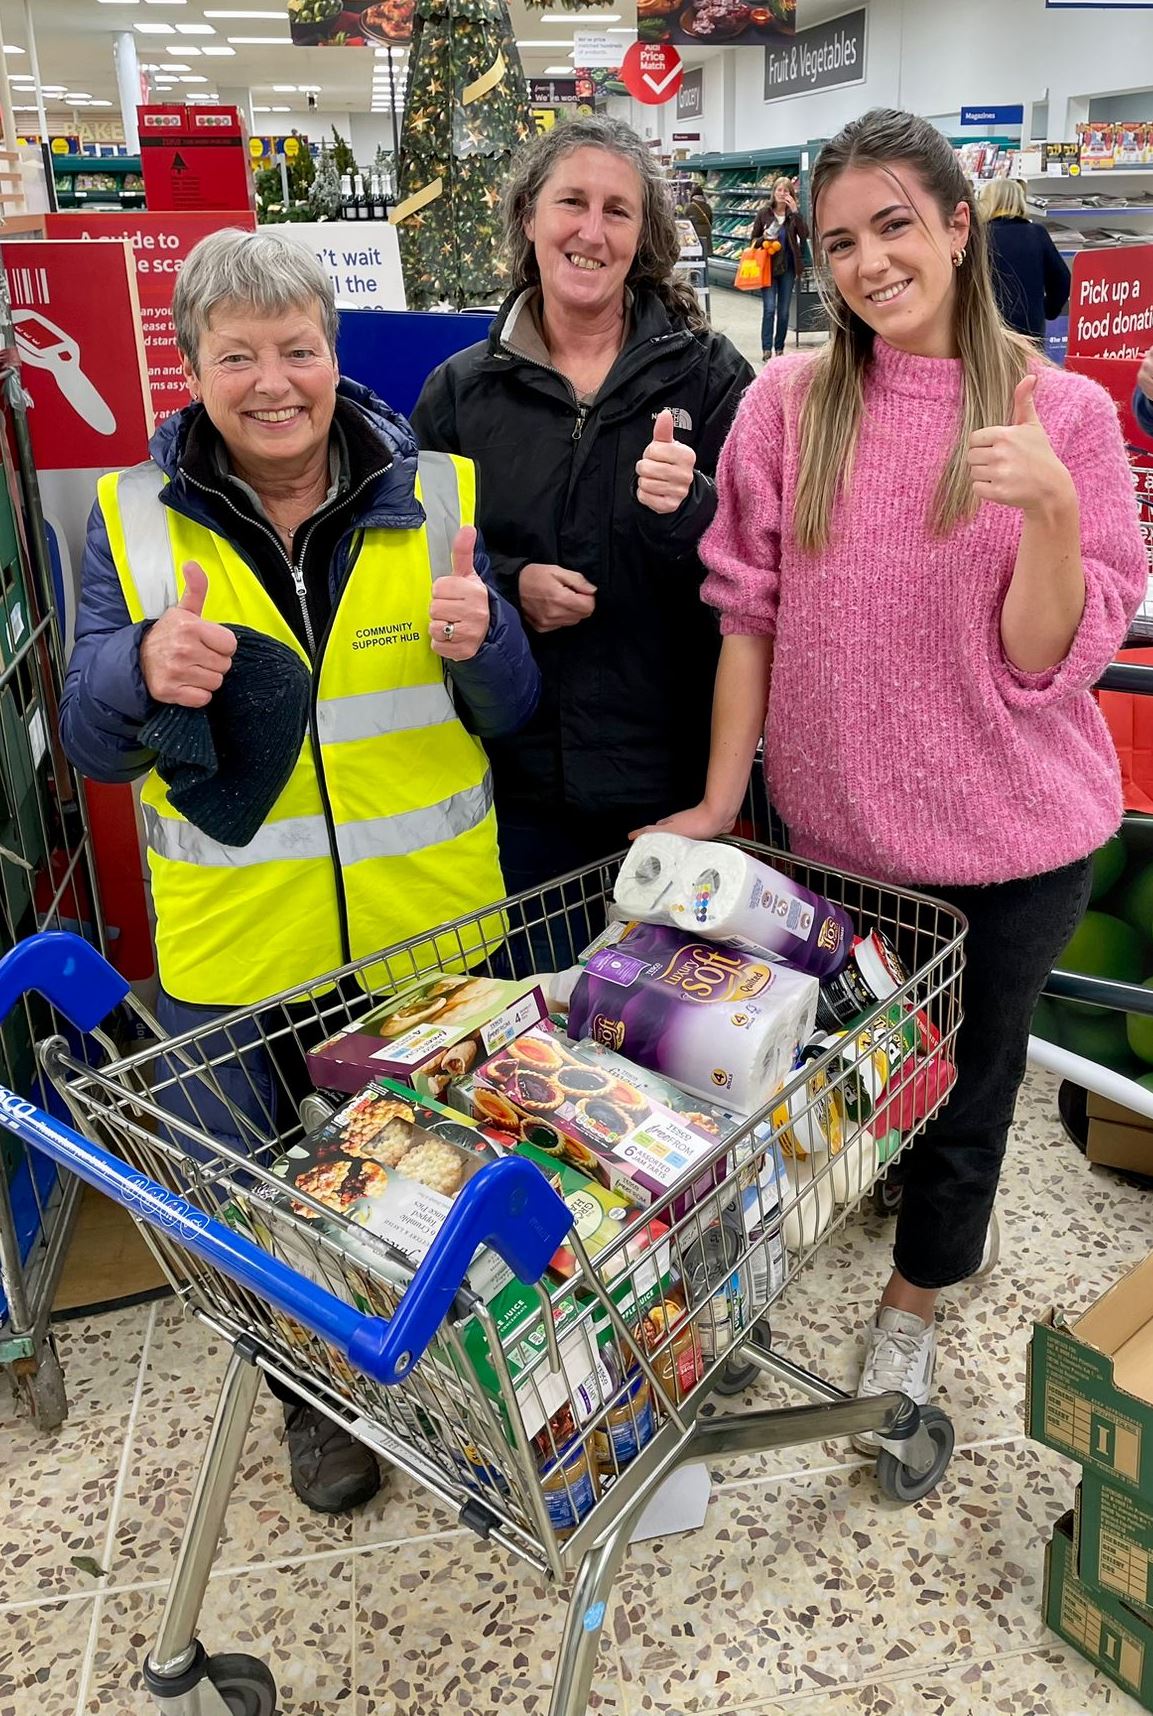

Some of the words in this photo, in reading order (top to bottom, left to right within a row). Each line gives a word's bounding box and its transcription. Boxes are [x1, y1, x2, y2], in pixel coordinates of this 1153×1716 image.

[640, 51, 666, 61] Price
[769, 51, 788, 85] Fruit
[790, 46, 798, 79] &
[800, 30, 857, 82] Vegetables
[640, 61, 666, 70] Match
[965, 112, 996, 120] Magazines
[158, 233, 180, 249] to
[136, 258, 149, 272] e
[342, 247, 382, 266] wait
[345, 274, 378, 293] the
[1080, 278, 1110, 306] Pick
[1112, 281, 1130, 307] up
[1132, 280, 1140, 298] a
[140, 308, 153, 316] an
[142, 321, 166, 331] ease
[1077, 312, 1111, 341] food
[153, 336, 176, 346] start
[162, 365, 183, 376] and
[167, 382, 178, 390] as
[355, 622, 413, 639] COMMUNITY
[351, 635, 398, 650] SUPPORT
[400, 632, 420, 643] HUB
[645, 963, 663, 977] TESCO
[663, 958, 701, 986] Luxury
[681, 948, 742, 997] Soft
[740, 971, 764, 993] Quilted
[515, 1012, 521, 1024] 4
[713, 1072, 725, 1083] 4
[0, 1086, 37, 1119] SCO
[666, 1123, 692, 1141] TESCO
[624, 1145, 638, 1157] 6
[633, 1149, 671, 1174] ASSORTED
[631, 1153, 646, 1168] JAM
[645, 1160, 667, 1180] TARTS
[399, 1214, 430, 1234] Crumble
[428, 1208, 447, 1222] ince
[503, 1299, 525, 1321] JUICE
[621, 1305, 637, 1320] PPLE
[638, 1290, 655, 1306] UICE
